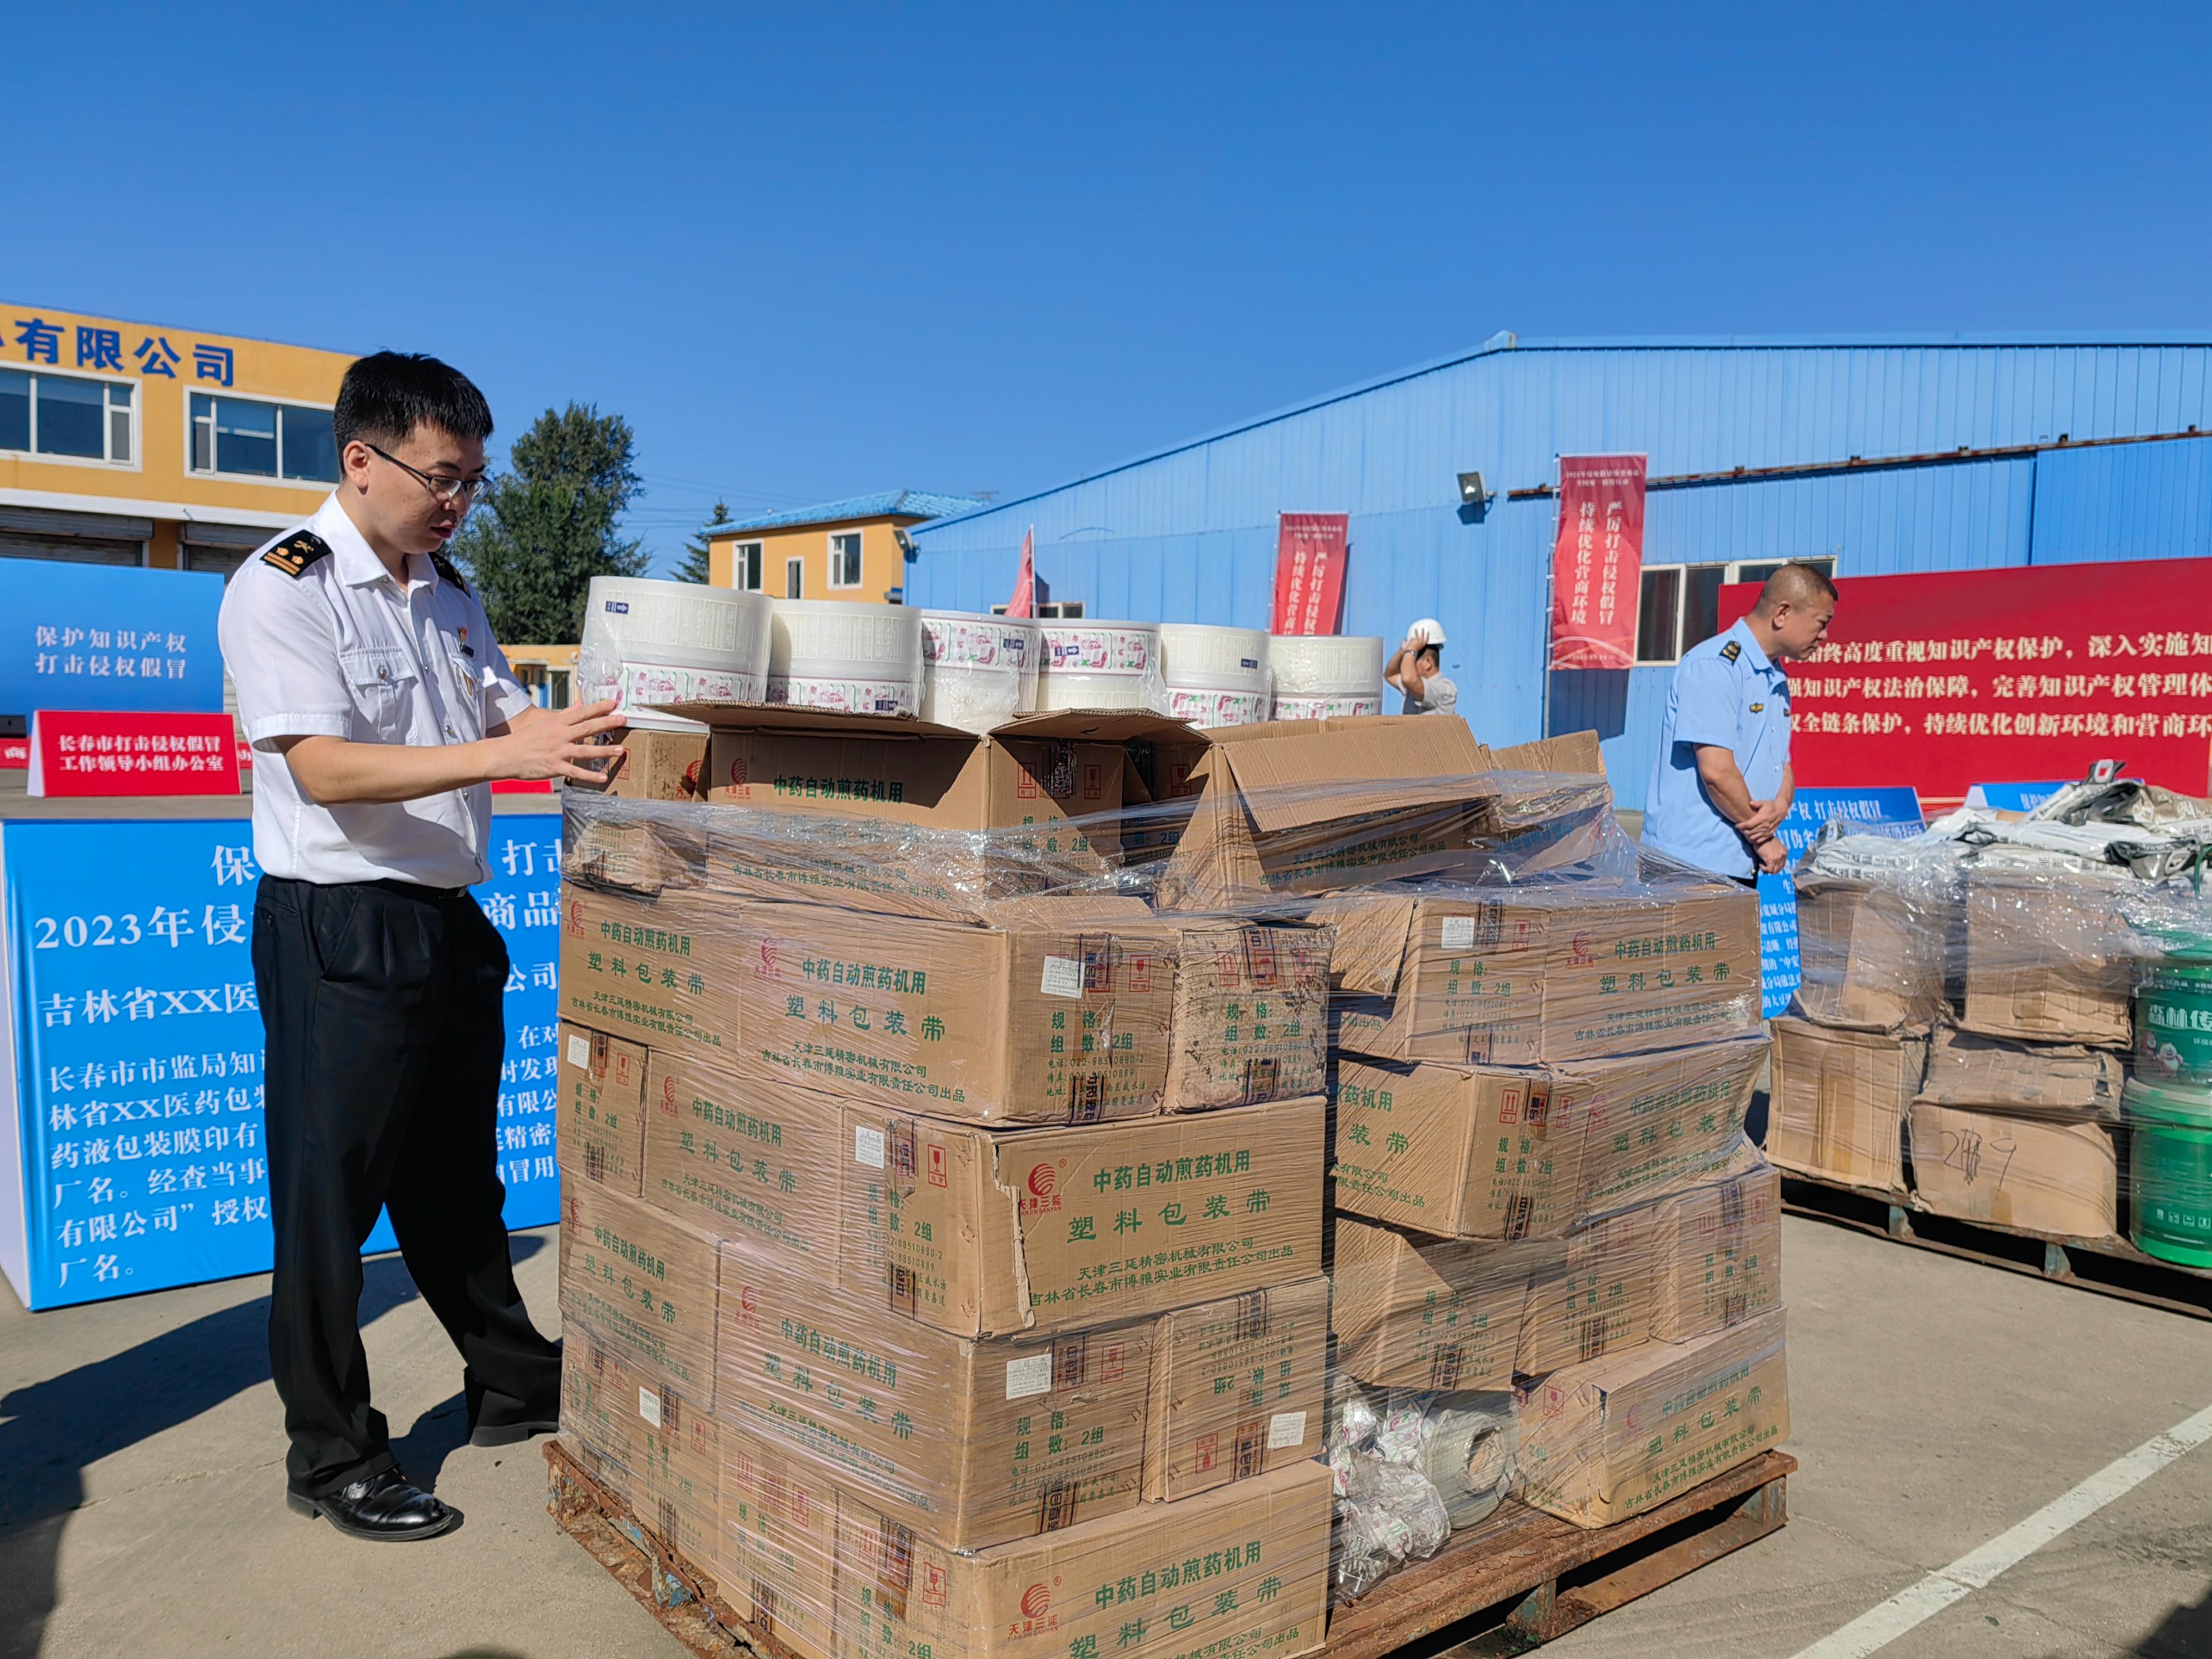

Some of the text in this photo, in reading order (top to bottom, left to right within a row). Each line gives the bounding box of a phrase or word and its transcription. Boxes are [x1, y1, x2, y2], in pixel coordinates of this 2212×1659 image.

[0, 318, 234, 387] 有限公司
[35, 625, 186, 653] 保护知识产权
[35, 653, 186, 680] 打击侵权假冒
[59, 734, 221, 753] 长春市打击侵权假冒
[60, 755, 224, 772] 工作领导小组办公室
[774, 774, 903, 803] 中药自动煎药机用
[211, 845, 256, 886] 保
[34, 891, 558, 949] 2023年侵 商品
[600, 919, 691, 956] 中药自动煎药机用
[1614, 931, 1716, 960] 中药自动煎药机用
[802, 957, 927, 995] 中药自动煎药机用
[38, 981, 259, 1028] 吉林省XX医
[784, 994, 946, 1042] 塑料包装带
[46, 1049, 265, 1093] 长春市市监局知
[1048, 1055, 1145, 1068] 电话:022-8850880-2
[496, 1122, 557, 1151] 精密
[692, 1097, 782, 1148] 中药自动煎药机用
[50, 1122, 259, 1170] 药液包装膜印有
[1093, 1150, 1251, 1193] 中药自动煎药机用
[1039, 1206, 1062, 1214] SANYAN
[1067, 1188, 1271, 1244] 塑料包装带
[593, 1224, 666, 1282] 中药自动煎药机用
[1076, 1237, 1254, 1282] 天津三延精密机械有限公司
[1029, 1244, 1294, 1307] 吉林省长春市博雅实业有限责任公司出品
[781, 1317, 897, 1389] 中药自动煎药机用
[1095, 1539, 1261, 1610] 中药自动煎药机用
